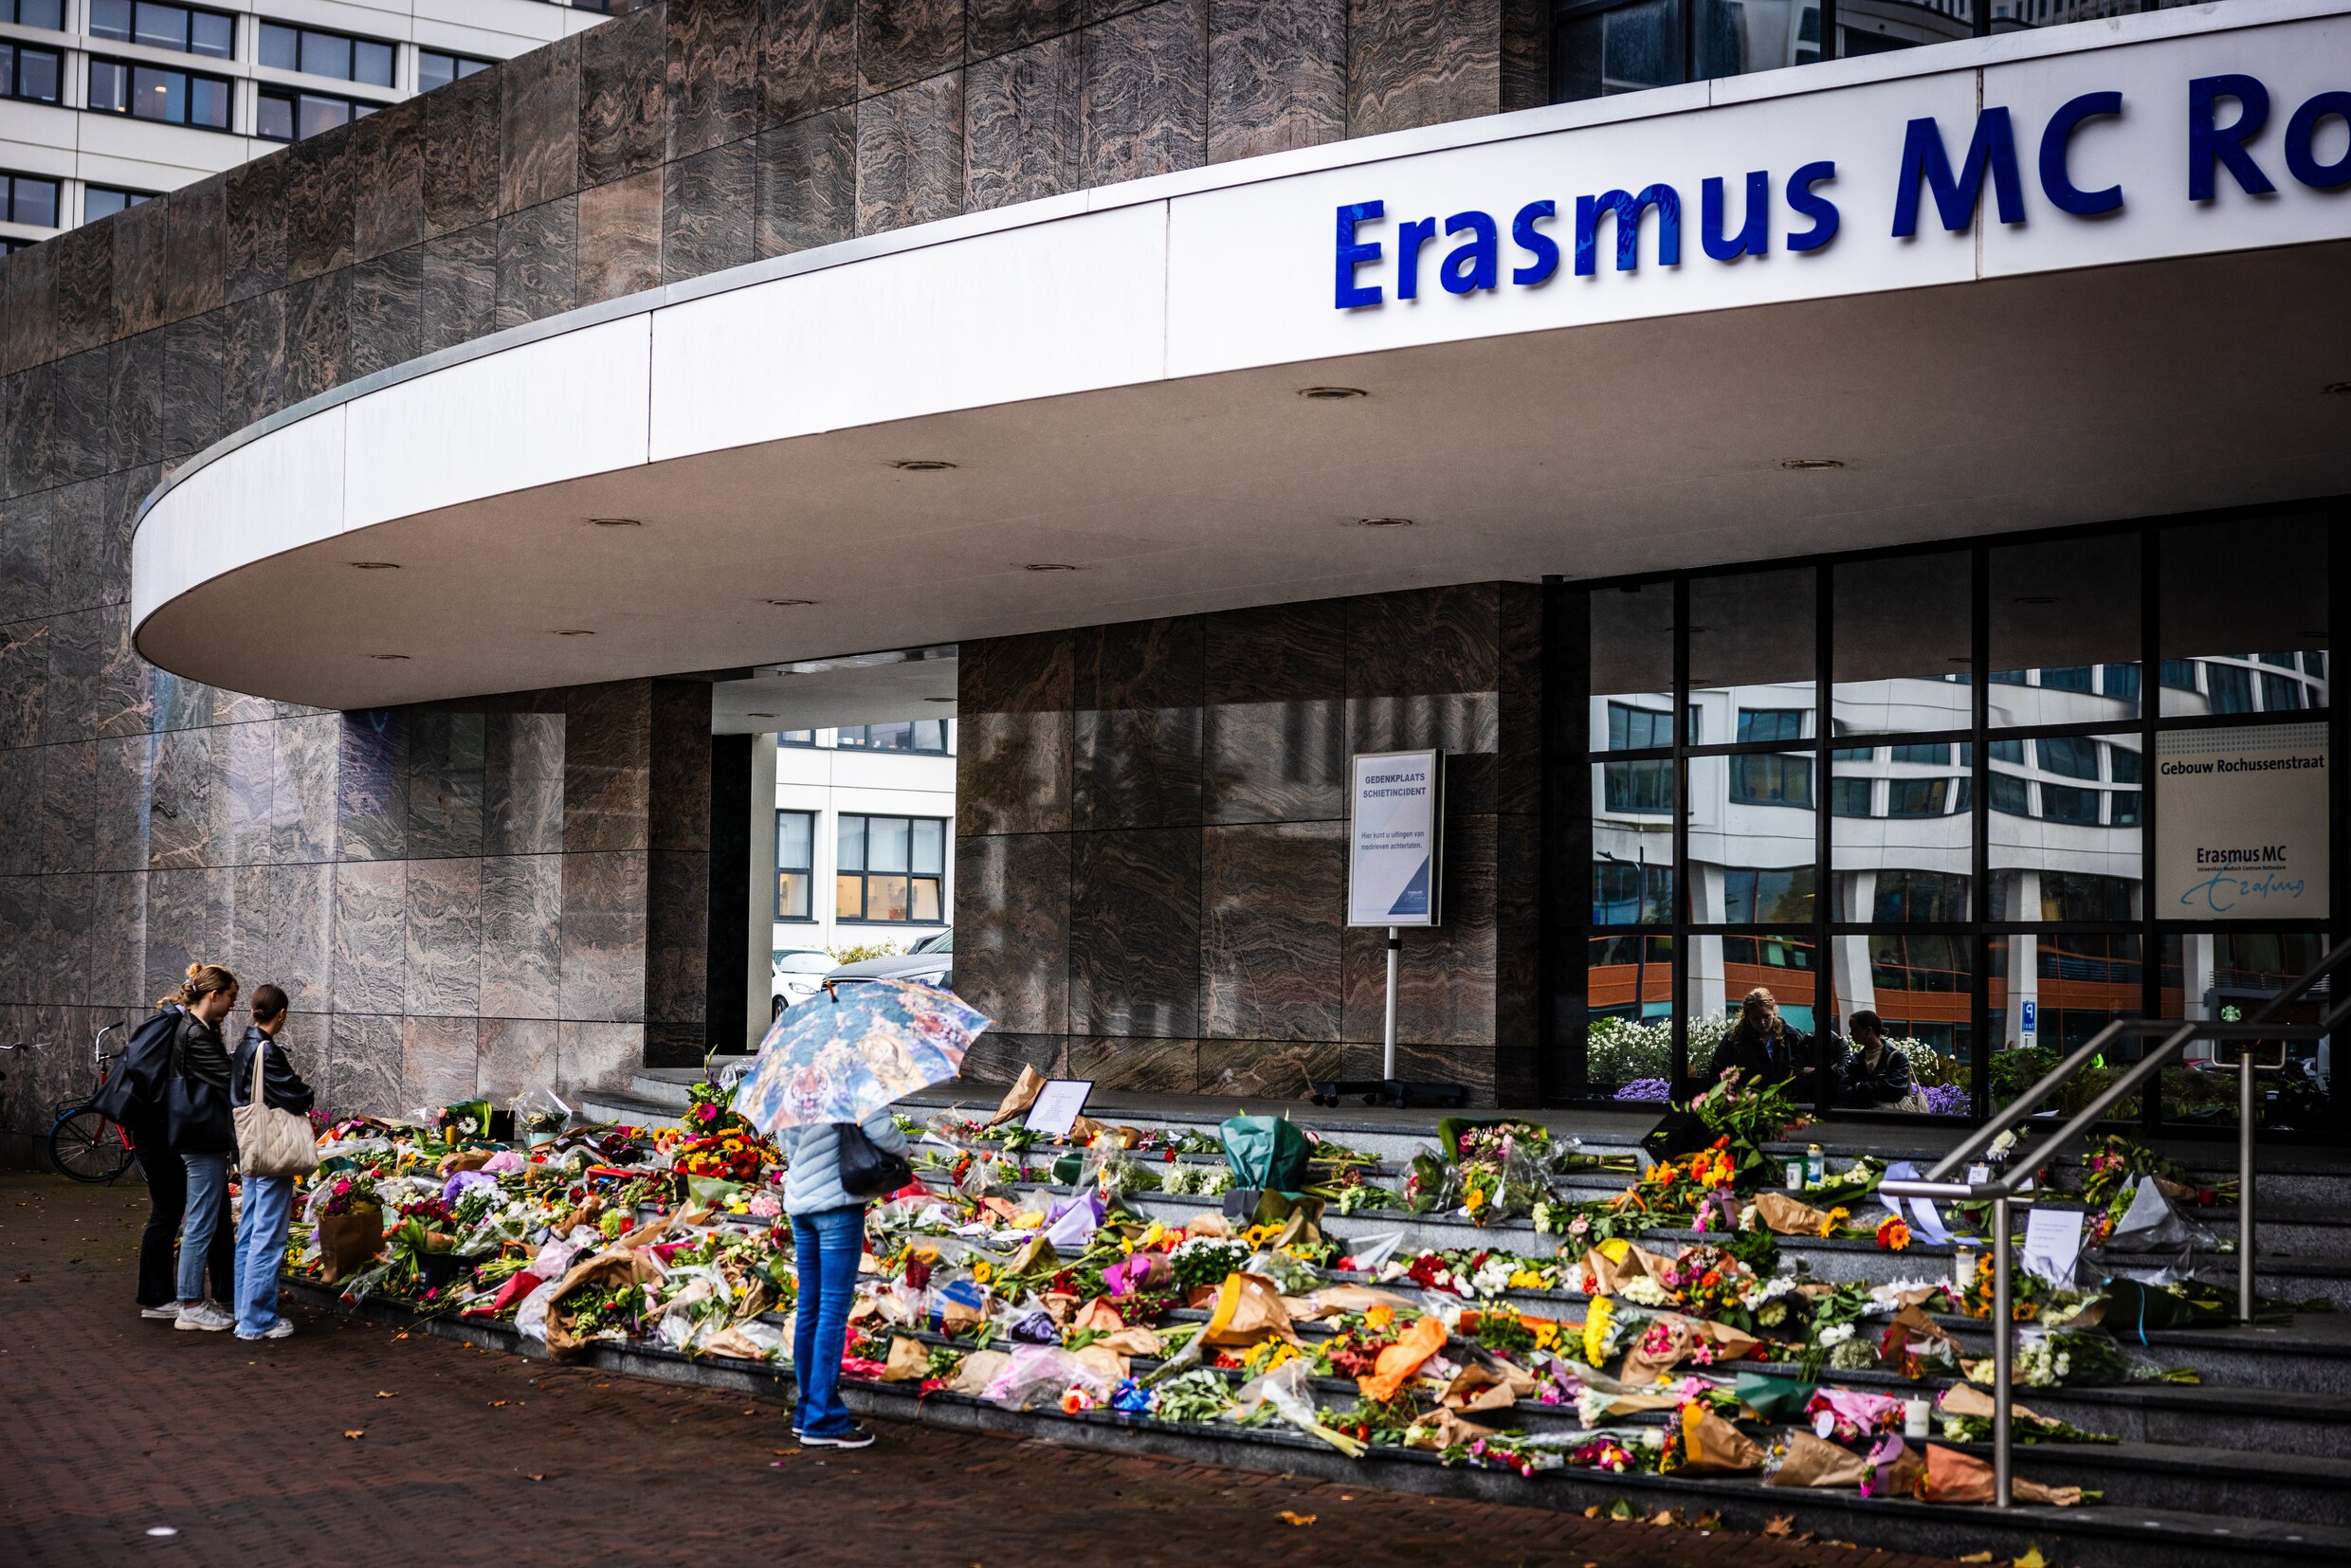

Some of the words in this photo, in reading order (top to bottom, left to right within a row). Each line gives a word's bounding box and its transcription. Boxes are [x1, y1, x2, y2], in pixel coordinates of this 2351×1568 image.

[1335, 161, 1840, 309] Erasmus
[1892, 91, 2123, 238] MC
[2160, 761, 2214, 775] Gebouw
[2217, 755, 2325, 773] Rochussenstraat
[1365, 773, 1425, 785] GEDENKPLAATS
[1363, 787, 1427, 798] SCHIETINCIDENT
[1391, 830, 1412, 841] uitingen
[2196, 848, 2260, 864] Erasmus
[2262, 846, 2287, 862] MC
